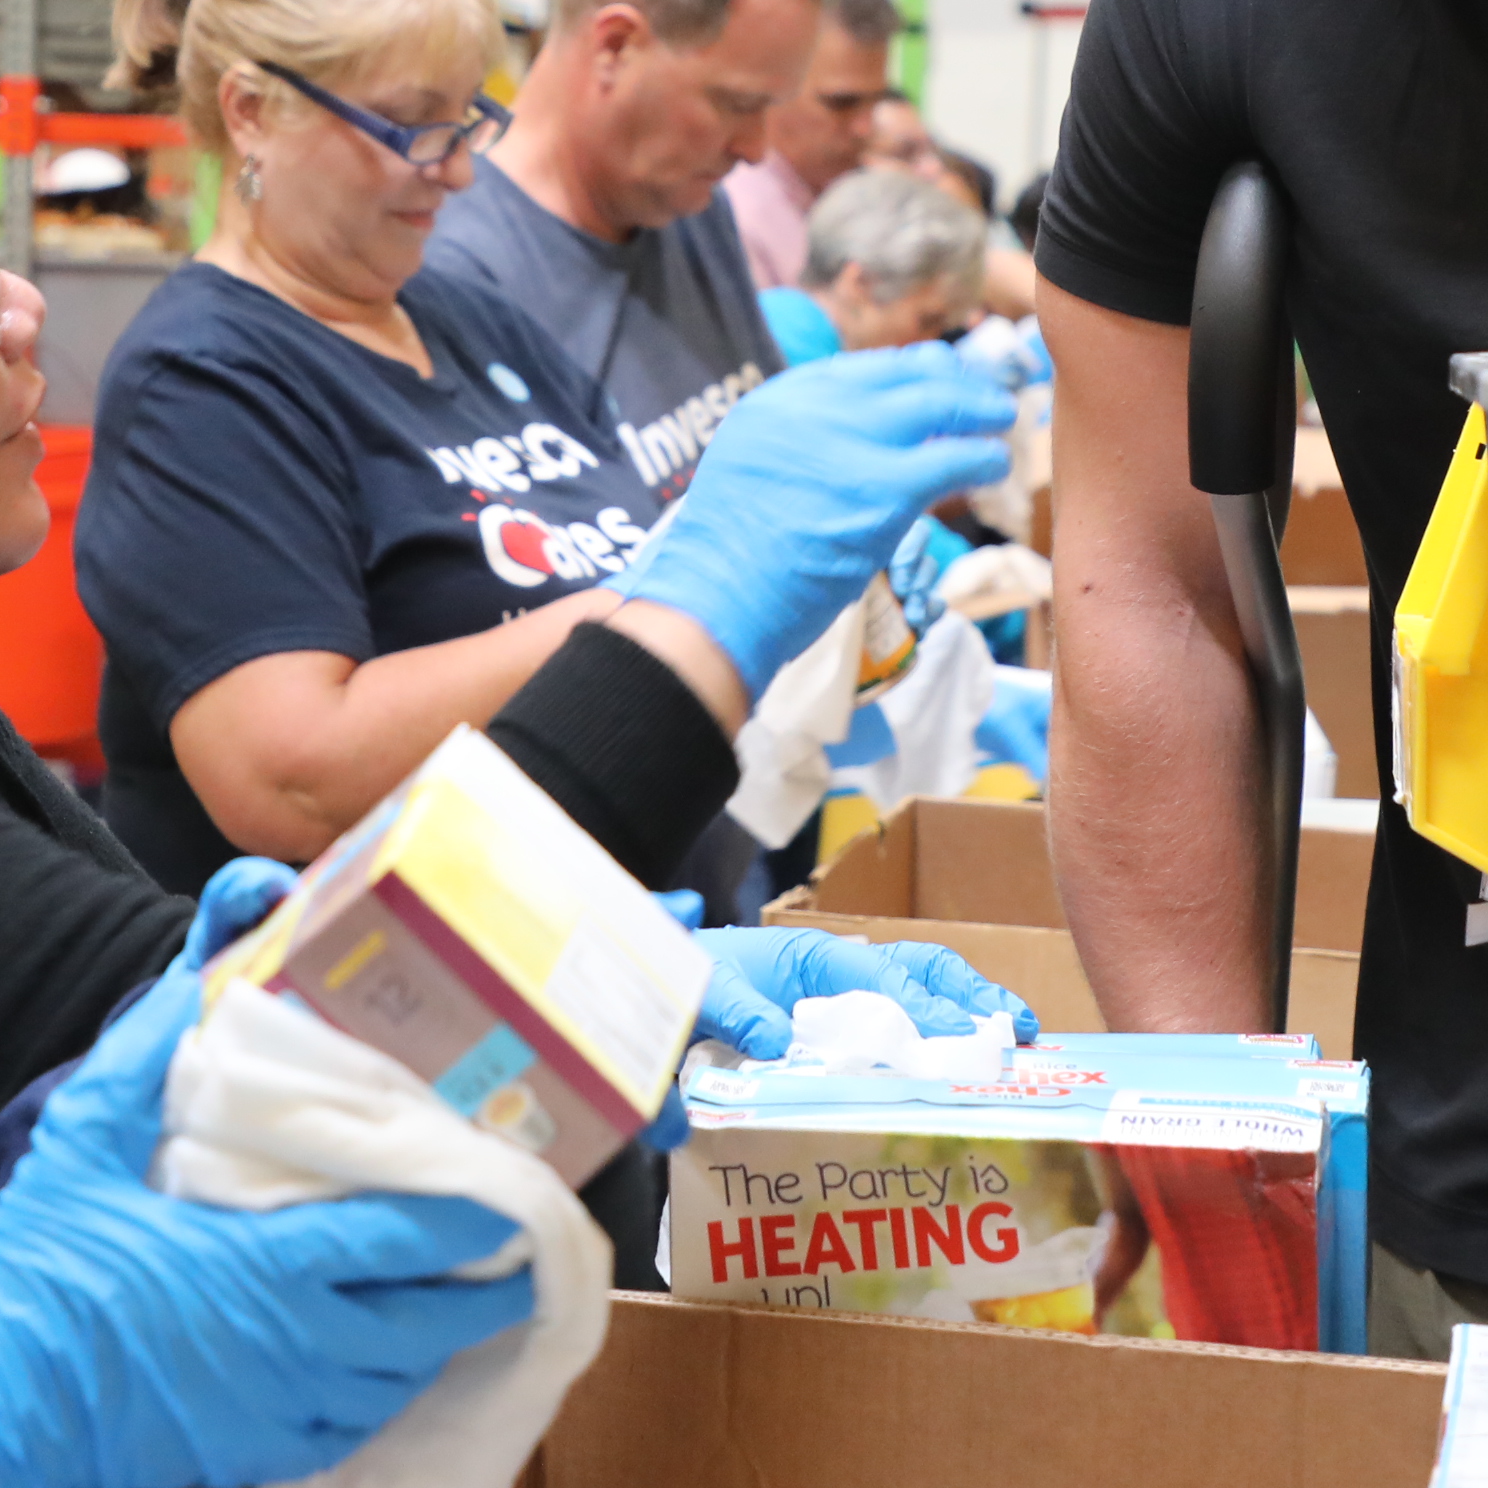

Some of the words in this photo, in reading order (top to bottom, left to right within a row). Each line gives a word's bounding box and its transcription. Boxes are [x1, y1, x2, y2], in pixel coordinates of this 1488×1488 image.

[1120, 1114, 1201, 1127] GRAIN
[1214, 1117, 1304, 1137] WHOLE
[708, 1163, 803, 1206] The
[815, 1161, 951, 1207] Party
[968, 1155, 1009, 1194] is
[707, 1200, 1020, 1284] HEATING
